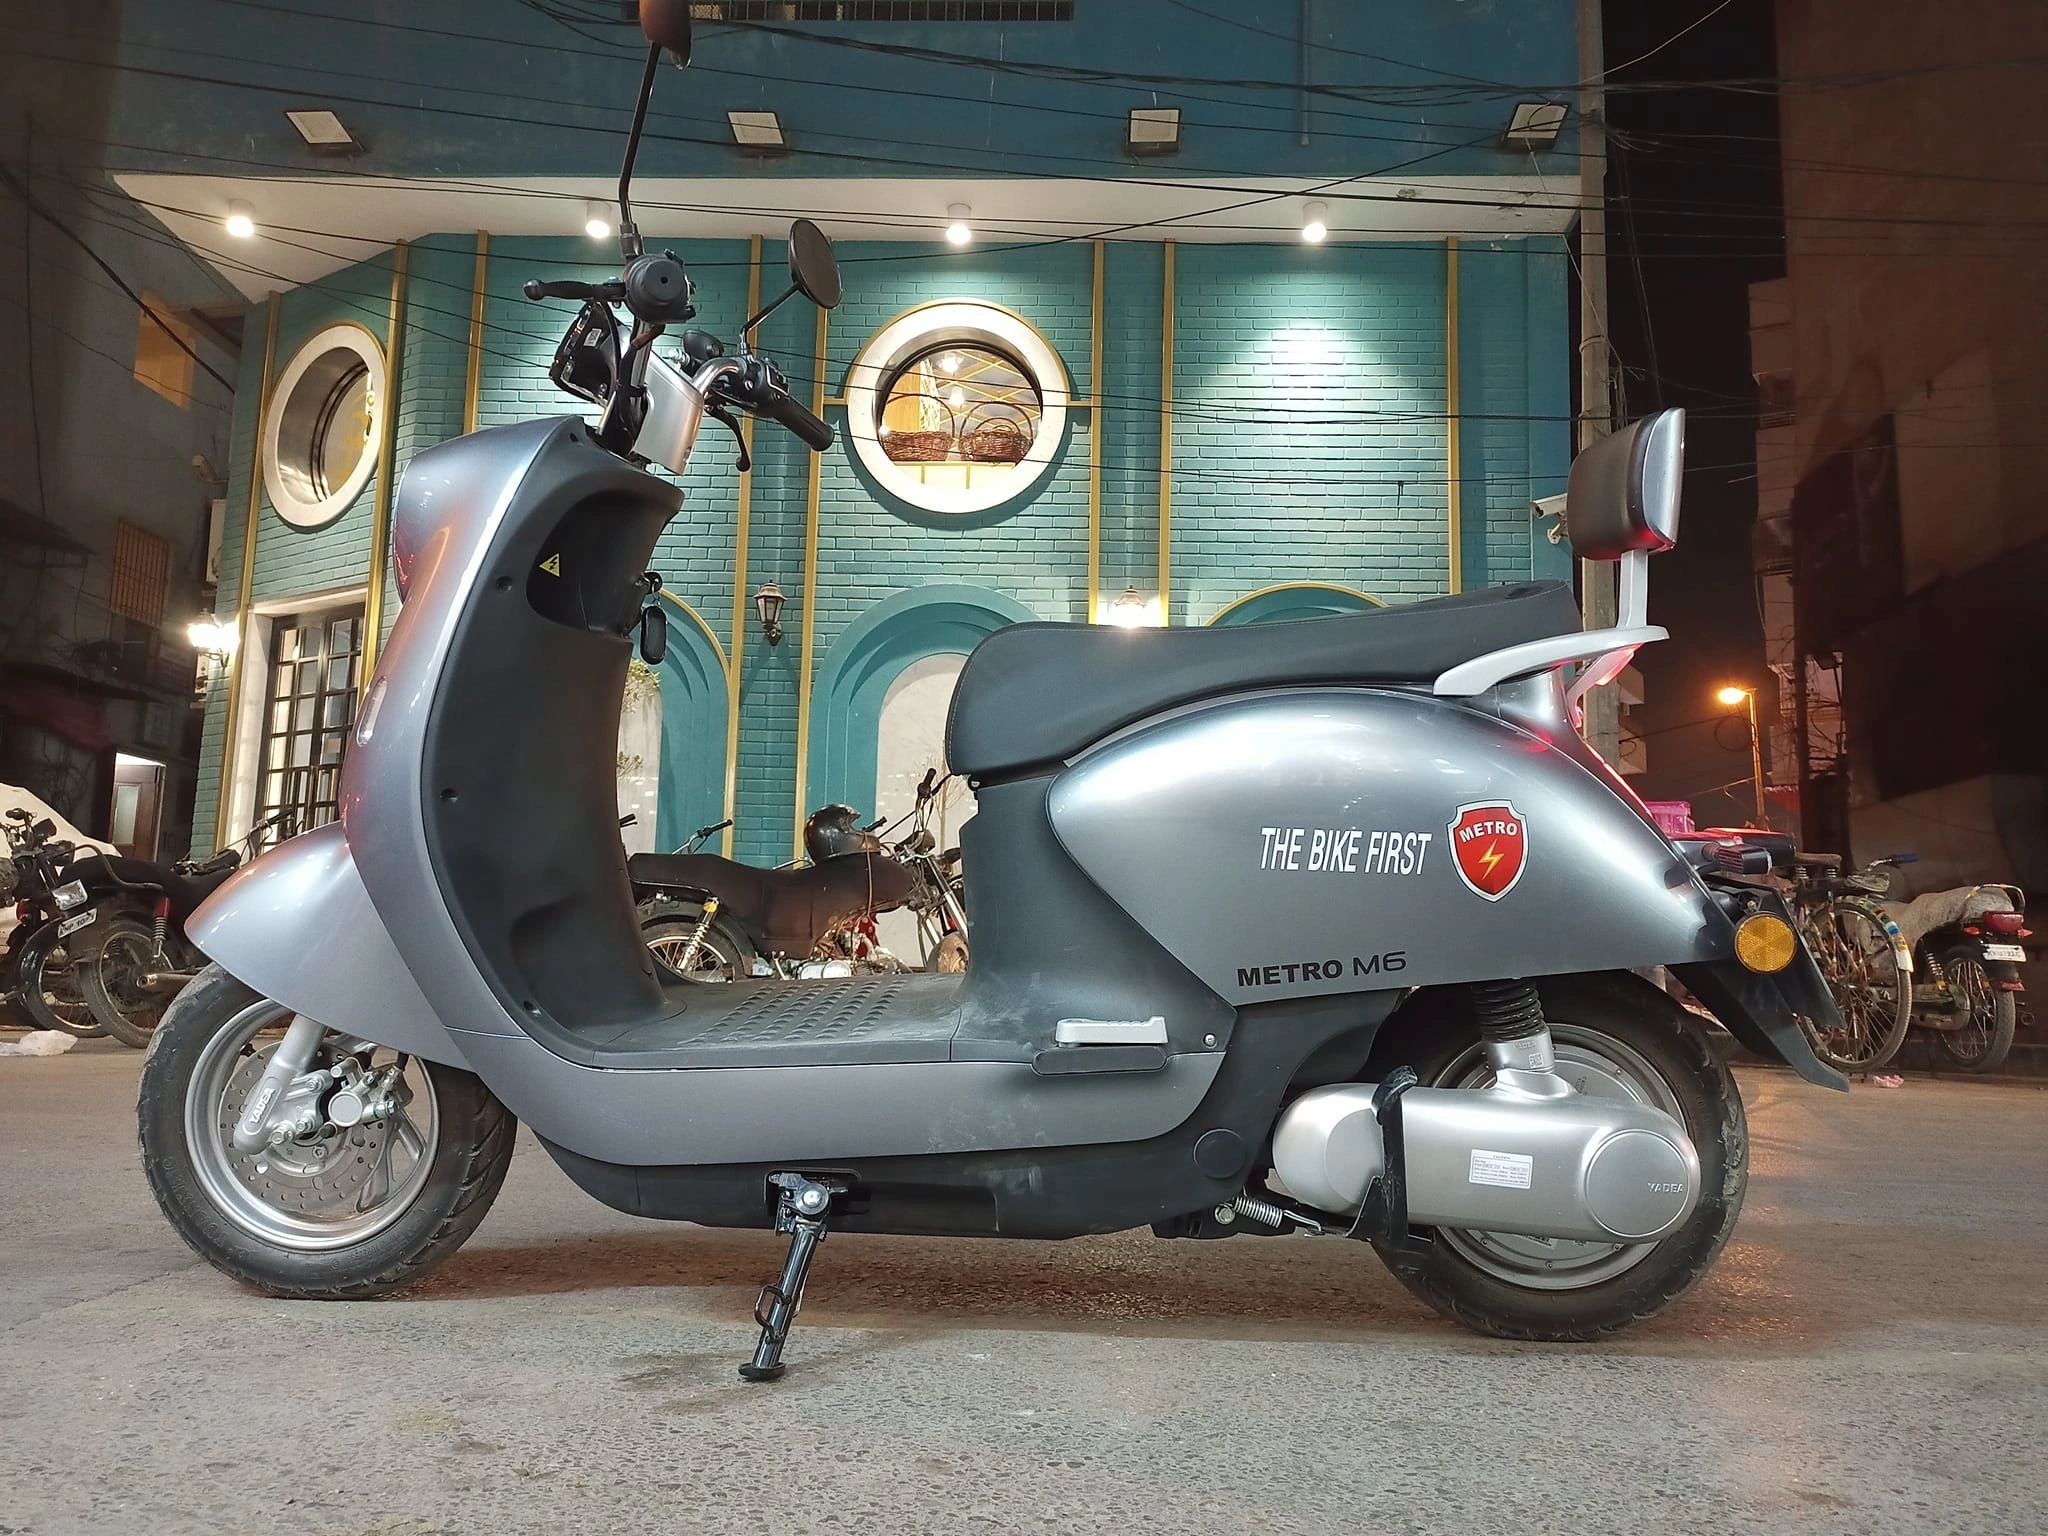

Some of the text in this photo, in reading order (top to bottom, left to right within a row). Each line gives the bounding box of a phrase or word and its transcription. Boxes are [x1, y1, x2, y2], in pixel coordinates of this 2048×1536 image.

[1458, 820, 1519, 843] METRO
[1260, 827, 1433, 876] THE BIKE FIRST
[1237, 951, 1407, 987] METRO M6
[249, 1087, 275, 1123] YADEA
[1647, 1182, 1684, 1193] YADEA
